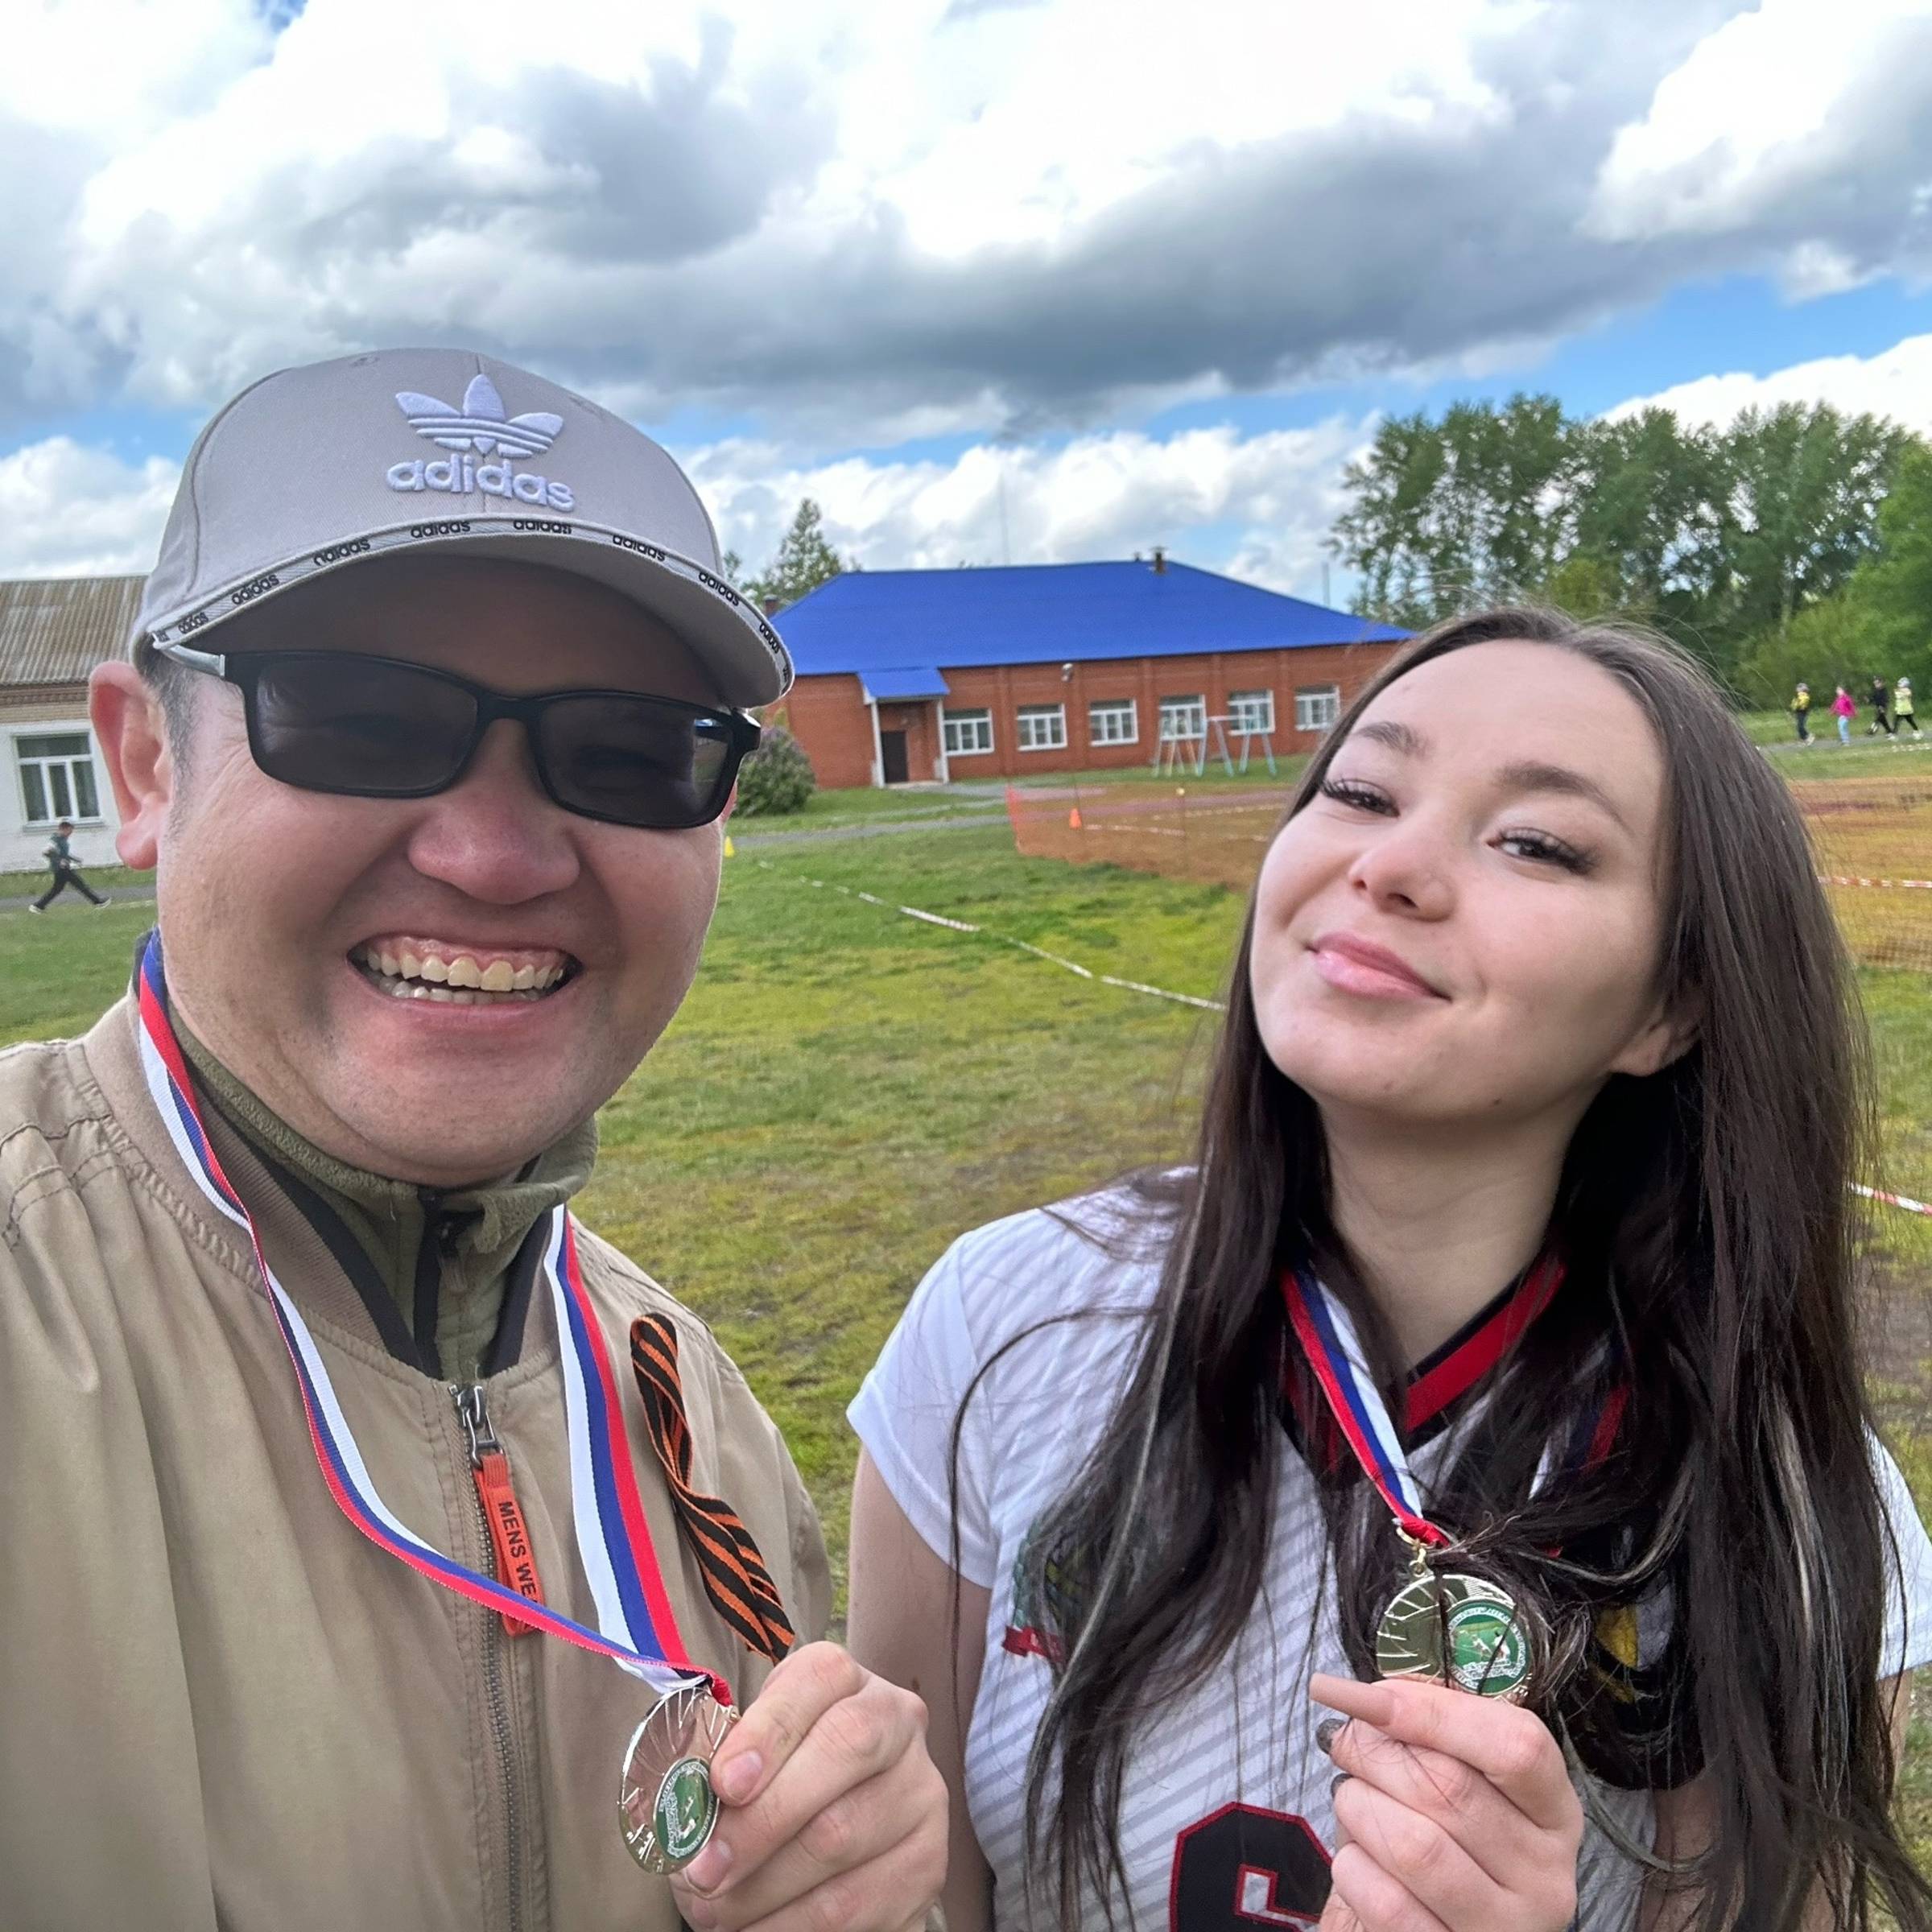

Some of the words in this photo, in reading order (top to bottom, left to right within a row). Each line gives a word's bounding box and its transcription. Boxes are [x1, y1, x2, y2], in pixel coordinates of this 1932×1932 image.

[387, 453, 575, 512] adidas
[410, 521, 471, 539] adidas
[513, 519, 572, 535] adidas
[312, 538, 371, 566] adidas
[613, 535, 666, 562] adidas
[232, 574, 279, 605] adidas
[699, 572, 740, 606] adidas
[498, 1501, 526, 1558] MENS
[516, 1562, 538, 1603] WE
